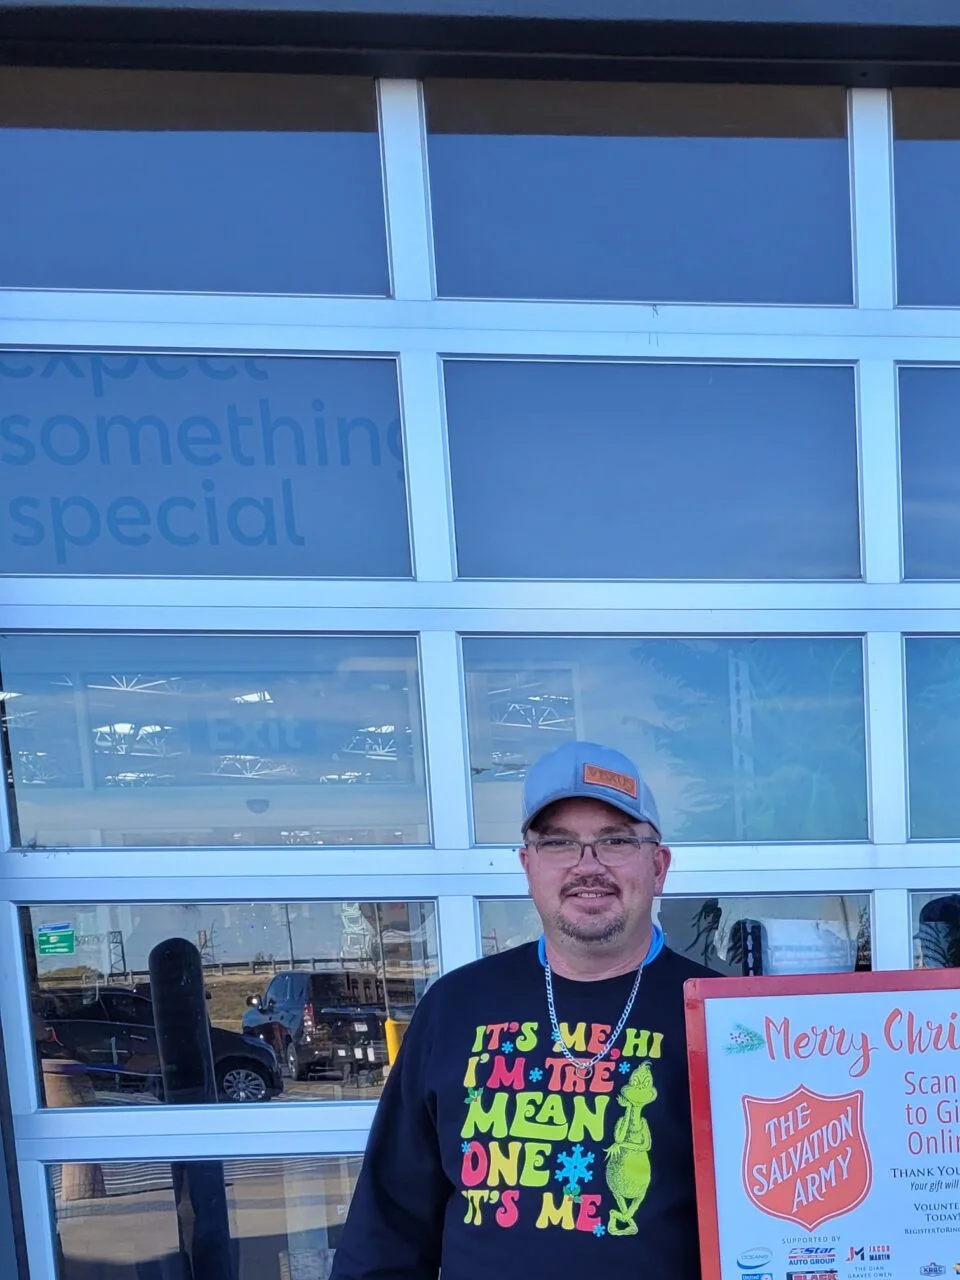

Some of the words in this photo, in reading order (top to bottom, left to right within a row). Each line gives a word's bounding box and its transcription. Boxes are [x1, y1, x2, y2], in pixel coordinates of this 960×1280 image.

[9, 478, 305, 564] special
[206, 711, 301, 751] Exit
[472, 1022, 538, 1052] IT'S
[622, 1028, 664, 1059] HI
[764, 1015, 878, 1078] Merry
[463, 1053, 526, 1090] I'M
[545, 1057, 615, 1093] THE
[904, 1071, 956, 1095] Scan
[461, 1092, 610, 1142] MEAN
[765, 1102, 812, 1148] THE
[905, 1104, 927, 1125] to
[461, 1141, 552, 1187] ONE
[752, 1106, 854, 1195] SALVATION
[792, 1147, 852, 1213] ARMY
[910, 1180, 927, 1192] Your
[929, 1180, 944, 1192] gift
[944, 1179, 959, 1190] will
[535, 1192, 603, 1233] ME
[782, 1236, 828, 1244] SUPPORTED
[832, 1235, 841, 1243] BY
[869, 1253, 891, 1261] MARTIN
